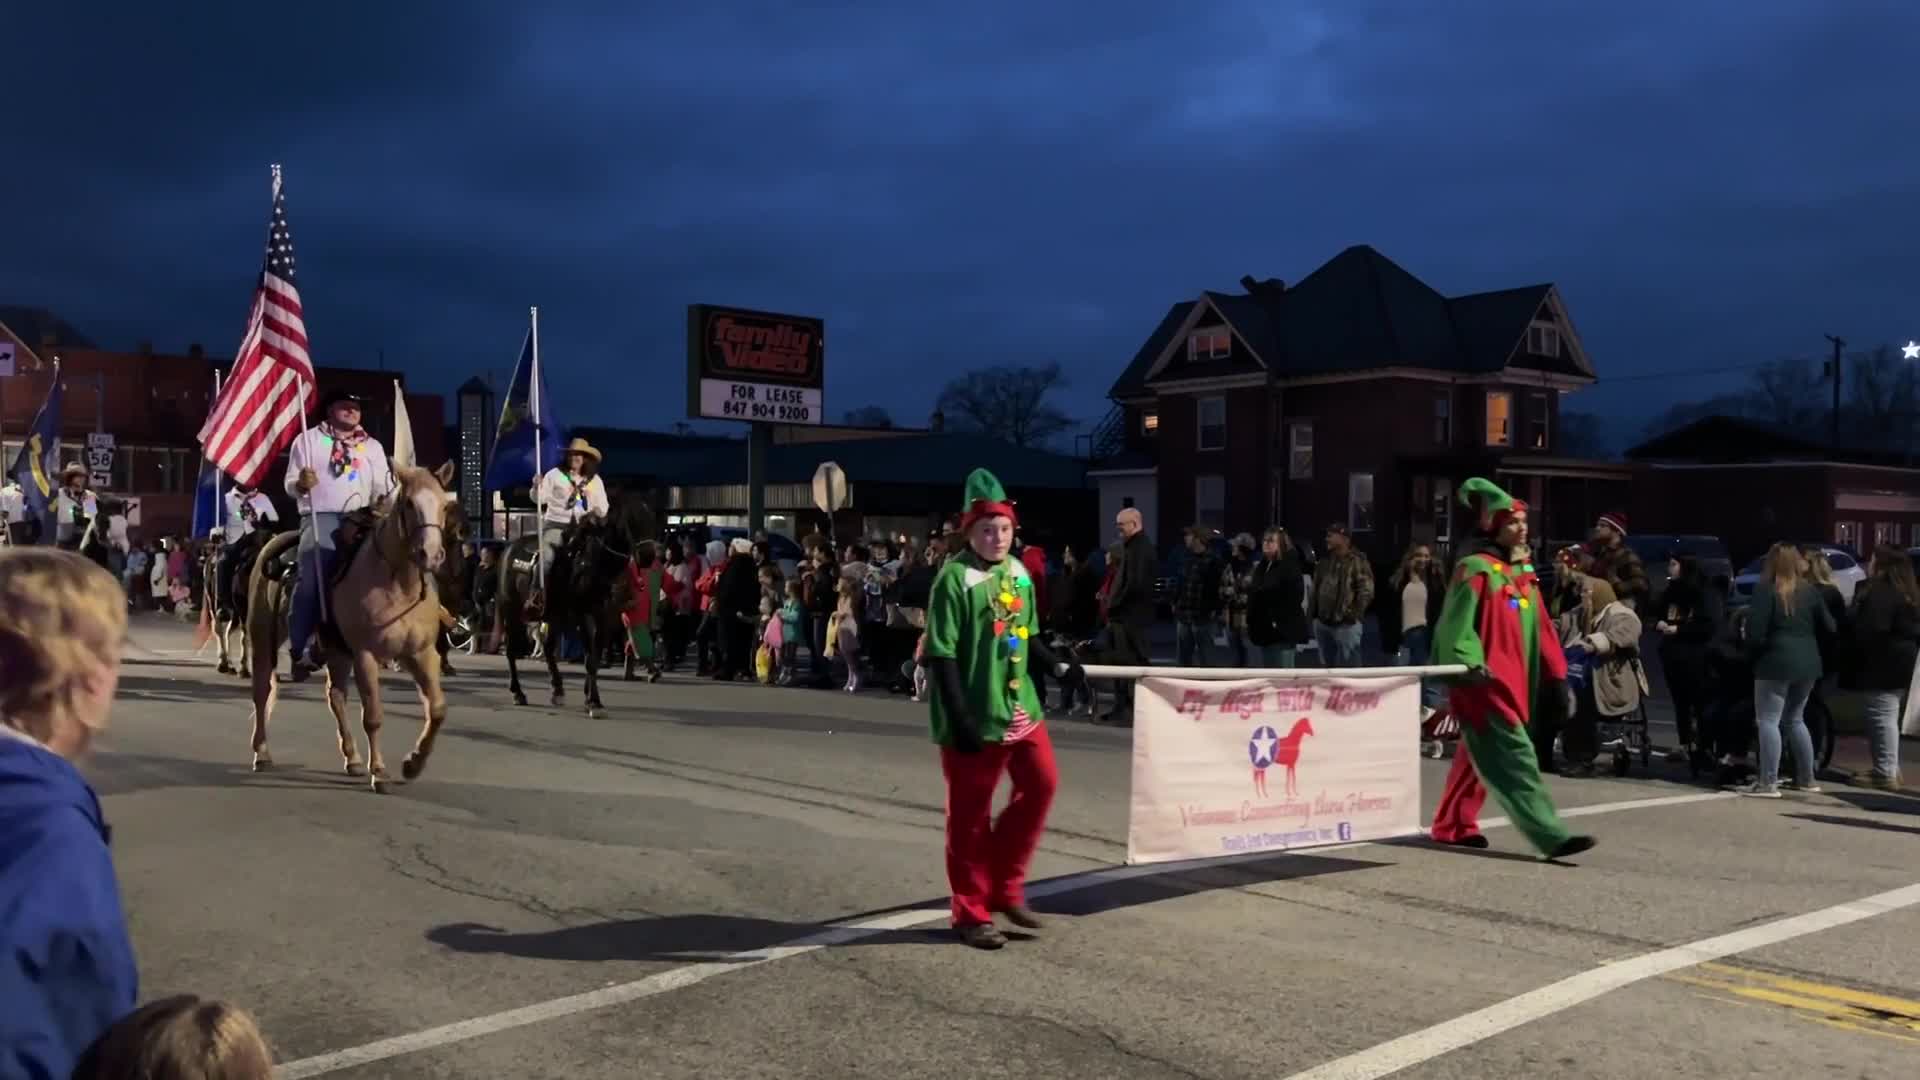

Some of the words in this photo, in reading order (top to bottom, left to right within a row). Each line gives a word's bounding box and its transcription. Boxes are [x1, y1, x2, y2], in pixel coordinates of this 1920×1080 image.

[731, 384, 755, 400] FOR
[766, 389, 803, 404] LEASE
[724, 400, 747, 415] 847
[752, 403, 775, 417] 904
[779, 406, 809, 420] 9200
[91, 453, 111, 466] 58
